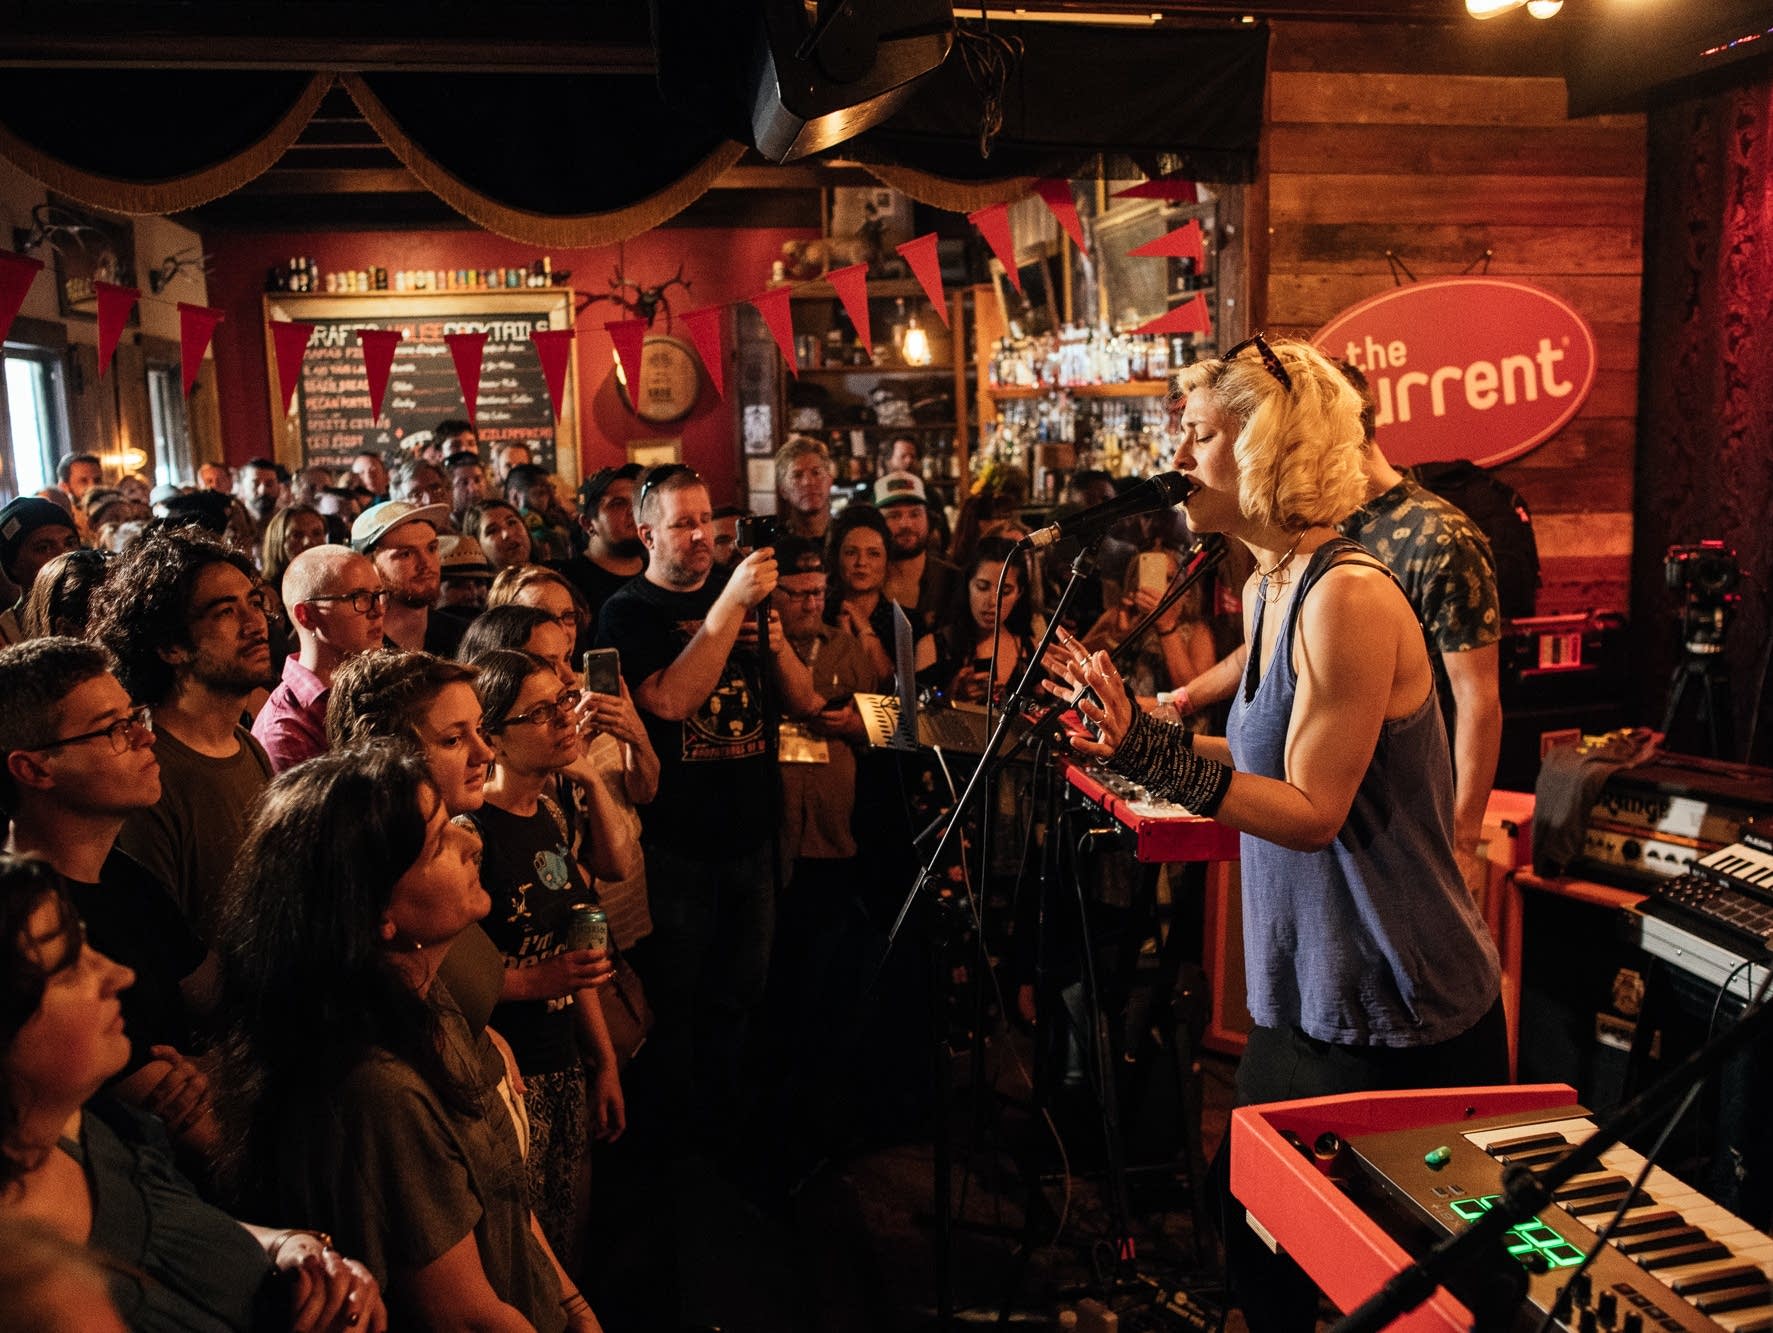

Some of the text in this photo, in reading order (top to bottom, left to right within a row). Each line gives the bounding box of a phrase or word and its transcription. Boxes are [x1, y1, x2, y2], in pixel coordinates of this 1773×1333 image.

[306, 323, 380, 347] RAFT
[1346, 336, 1407, 371] the
[1374, 338, 1574, 428] urrent
